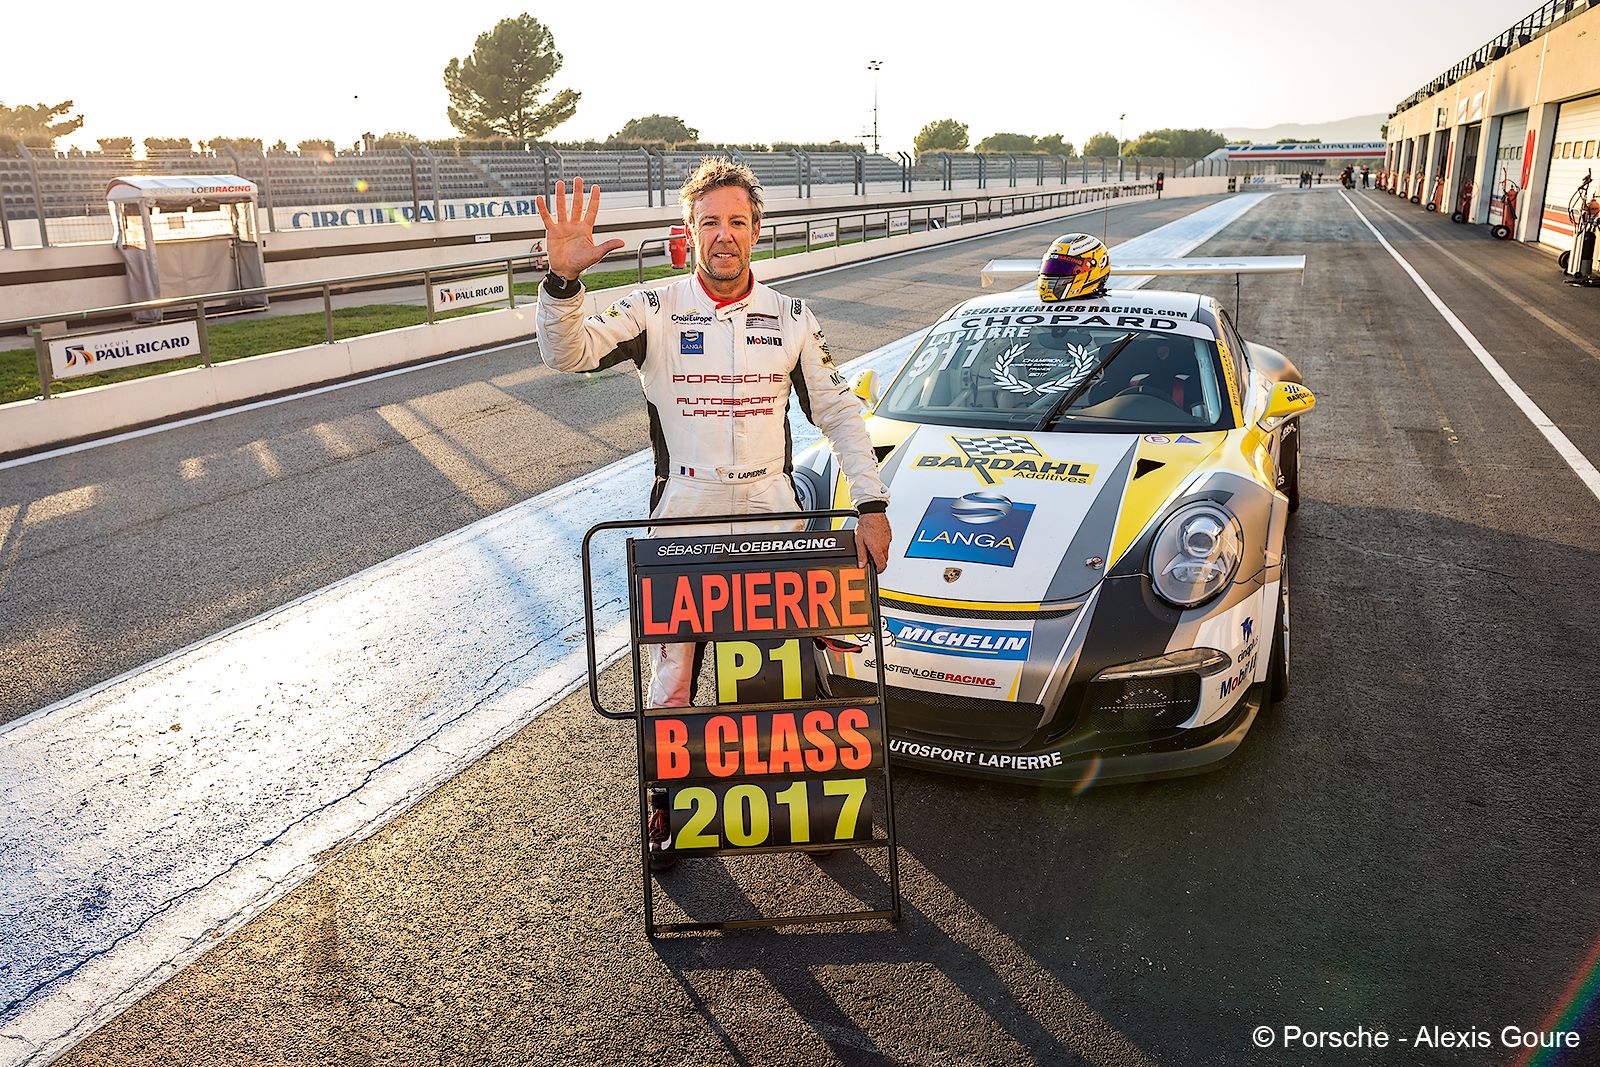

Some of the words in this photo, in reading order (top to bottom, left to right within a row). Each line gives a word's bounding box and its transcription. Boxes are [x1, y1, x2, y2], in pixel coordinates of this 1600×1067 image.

[292, 208, 398, 229] CIRCUIT
[455, 290, 475, 301] PAUL
[475, 285, 504, 298] RICARD
[961, 314, 1178, 330] CHOPARD
[95, 340, 129, 349] CIRCUIT
[96, 346, 135, 361] PAUL
[136, 336, 190, 354] RICARD
[746, 335, 773, 345] Mobil
[908, 340, 987, 378] 911
[737, 467, 768, 480] LAPIERRE
[916, 455, 1091, 485] BARDAHL
[1012, 471, 1087, 485] Additives
[657, 537, 838, 558] SÉBASTIENLOEBRACING
[917, 529, 1016, 551] LANGA
[641, 568, 869, 636] LAPIERRE
[897, 626, 1028, 651] MICHELIN
[716, 638, 803, 704] P1
[863, 659, 996, 686] SÉASTIENLOEBRACING
[654, 718, 692, 780] B
[703, 708, 873, 779] CLASS
[889, 739, 976, 764] UTOSPORT
[978, 752, 1063, 770] LAPIERRE
[673, 778, 868, 850] 2017
